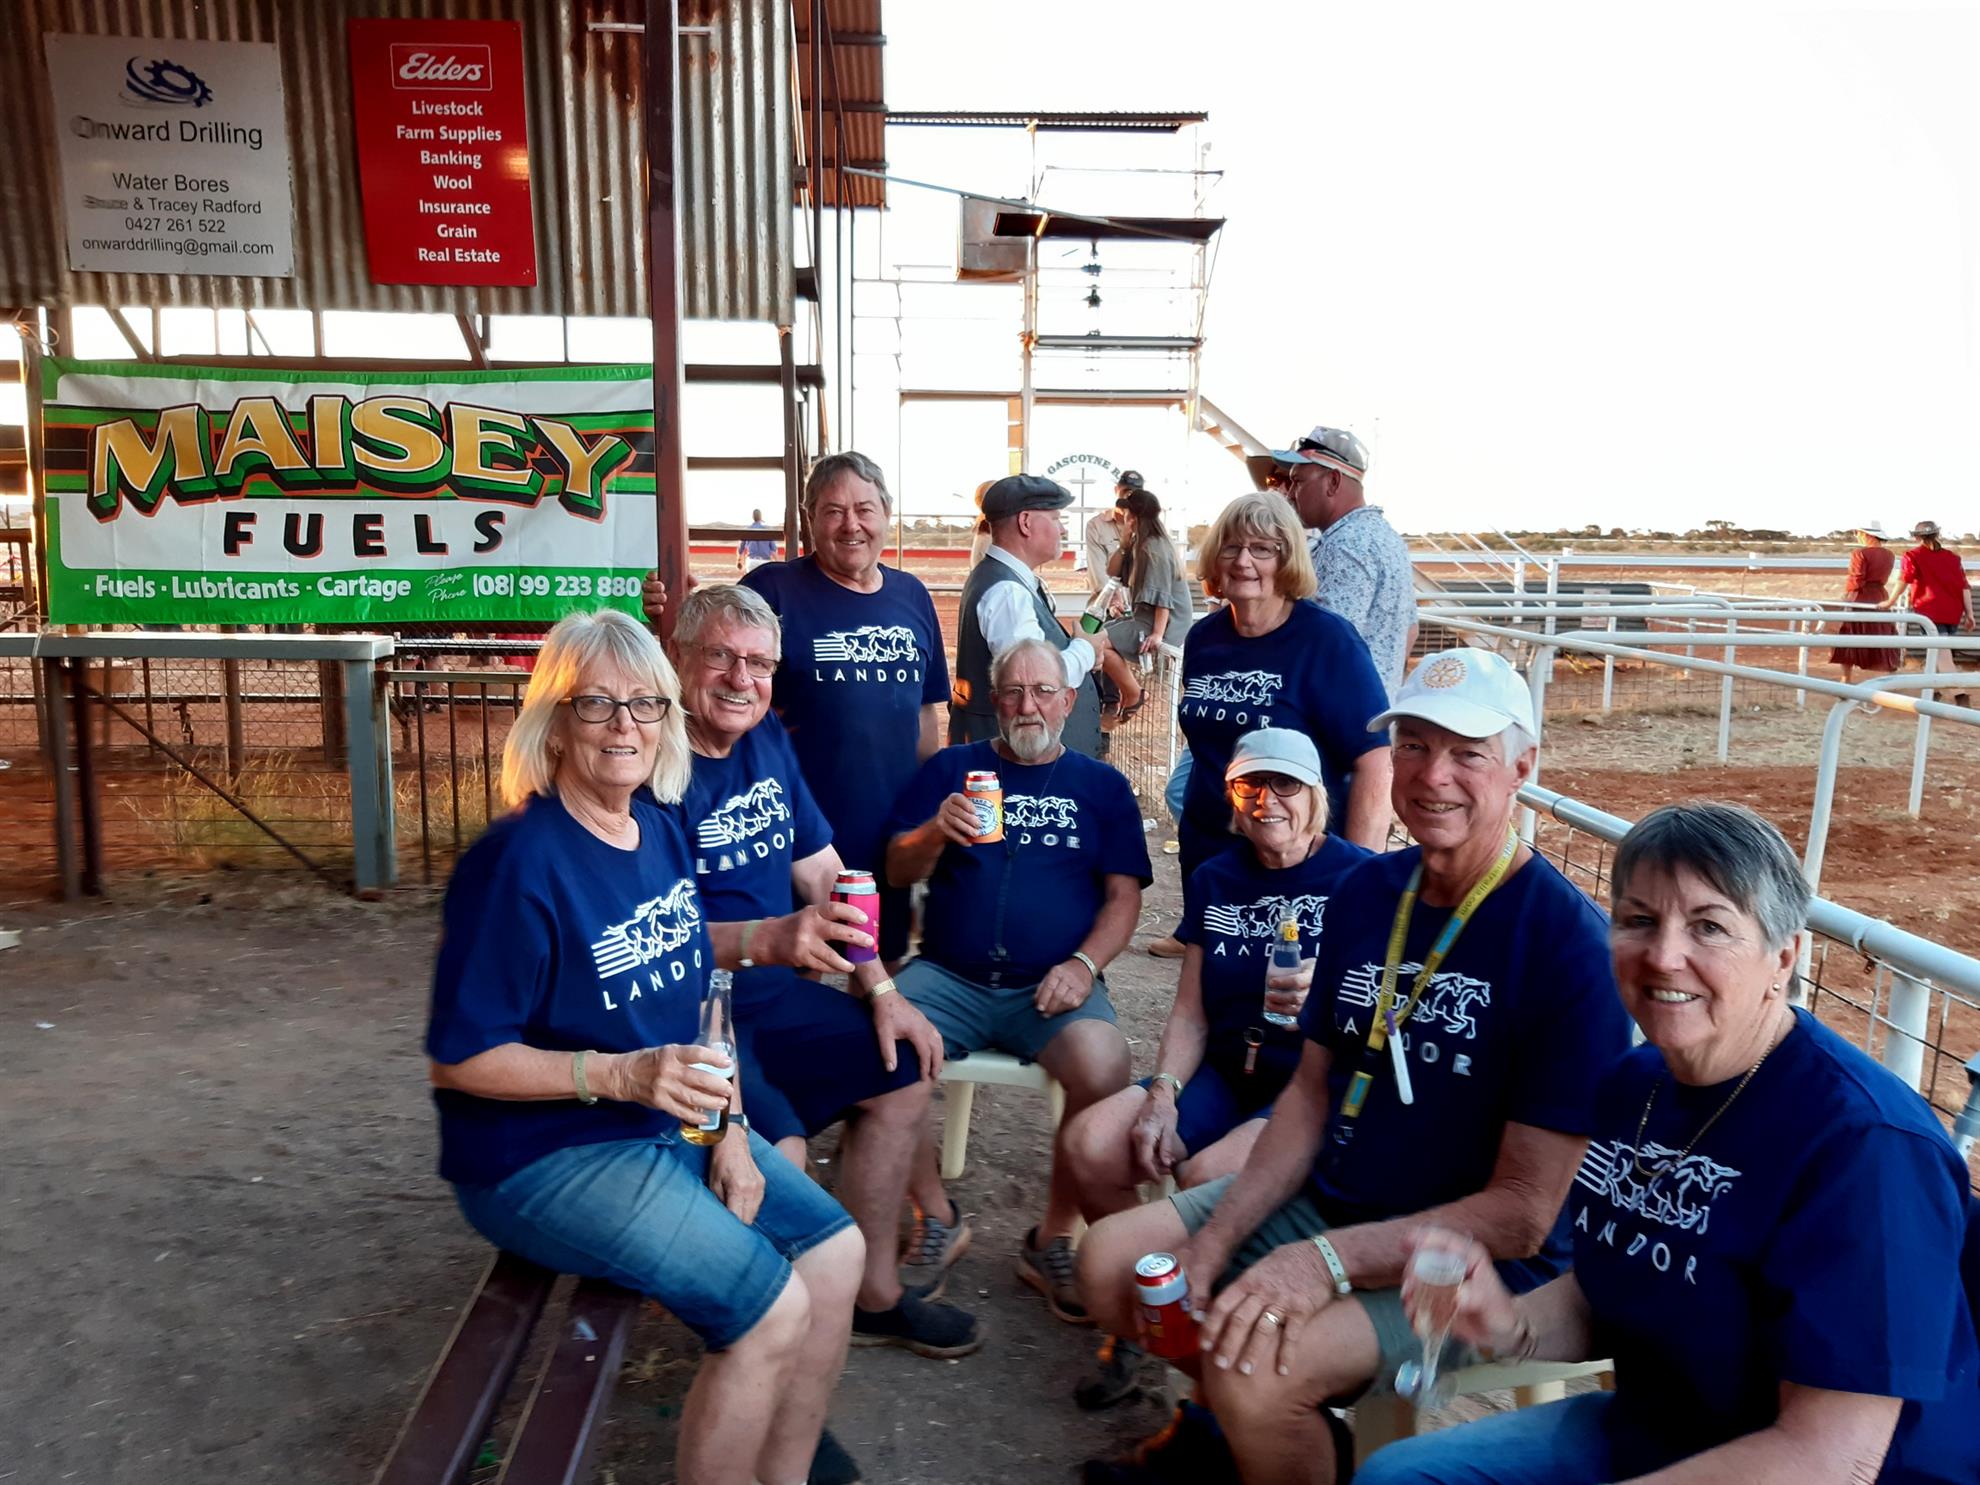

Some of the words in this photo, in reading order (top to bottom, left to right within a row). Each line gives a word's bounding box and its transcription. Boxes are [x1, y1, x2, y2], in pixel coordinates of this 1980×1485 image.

[399, 52, 484, 81] Elders
[412, 101, 483, 116] Livestock
[70, 115, 170, 141] Onward
[180, 121, 262, 150] Drilling
[397, 125, 434, 139] Farm
[439, 126, 502, 144] Supplies
[421, 151, 481, 169] Banking
[113, 172, 168, 191] Water
[175, 174, 229, 192] Bores
[433, 175, 472, 189] Wool
[133, 197, 144, 211] &
[148, 197, 198, 215] Tracey
[203, 199, 262, 214] Radford
[419, 200, 491, 214] Insurance
[125, 217, 161, 231] 0427
[167, 218, 193, 232] 261
[199, 219, 226, 233] 522
[437, 224, 477, 238] Grain
[82, 238, 274, 255] onwarddrilling@gmail.com
[419, 248, 449, 262] Real
[455, 249, 500, 263] Estate
[87, 395, 636, 524] MAISEY
[223, 511, 505, 558] FUELS
[96, 574, 156, 599] Fuels
[172, 576, 300, 600] Lubricants
[317, 575, 411, 601] Cartage
[428, 587, 467, 604] Phone
[519, 575, 550, 597] 99
[555, 575, 592, 597] 233
[597, 575, 641, 597] 880
[1181, 703, 1271, 729] ANDOR
[603, 949, 701, 1010] LANDO
[1575, 1206, 1697, 1285] ANDOR
